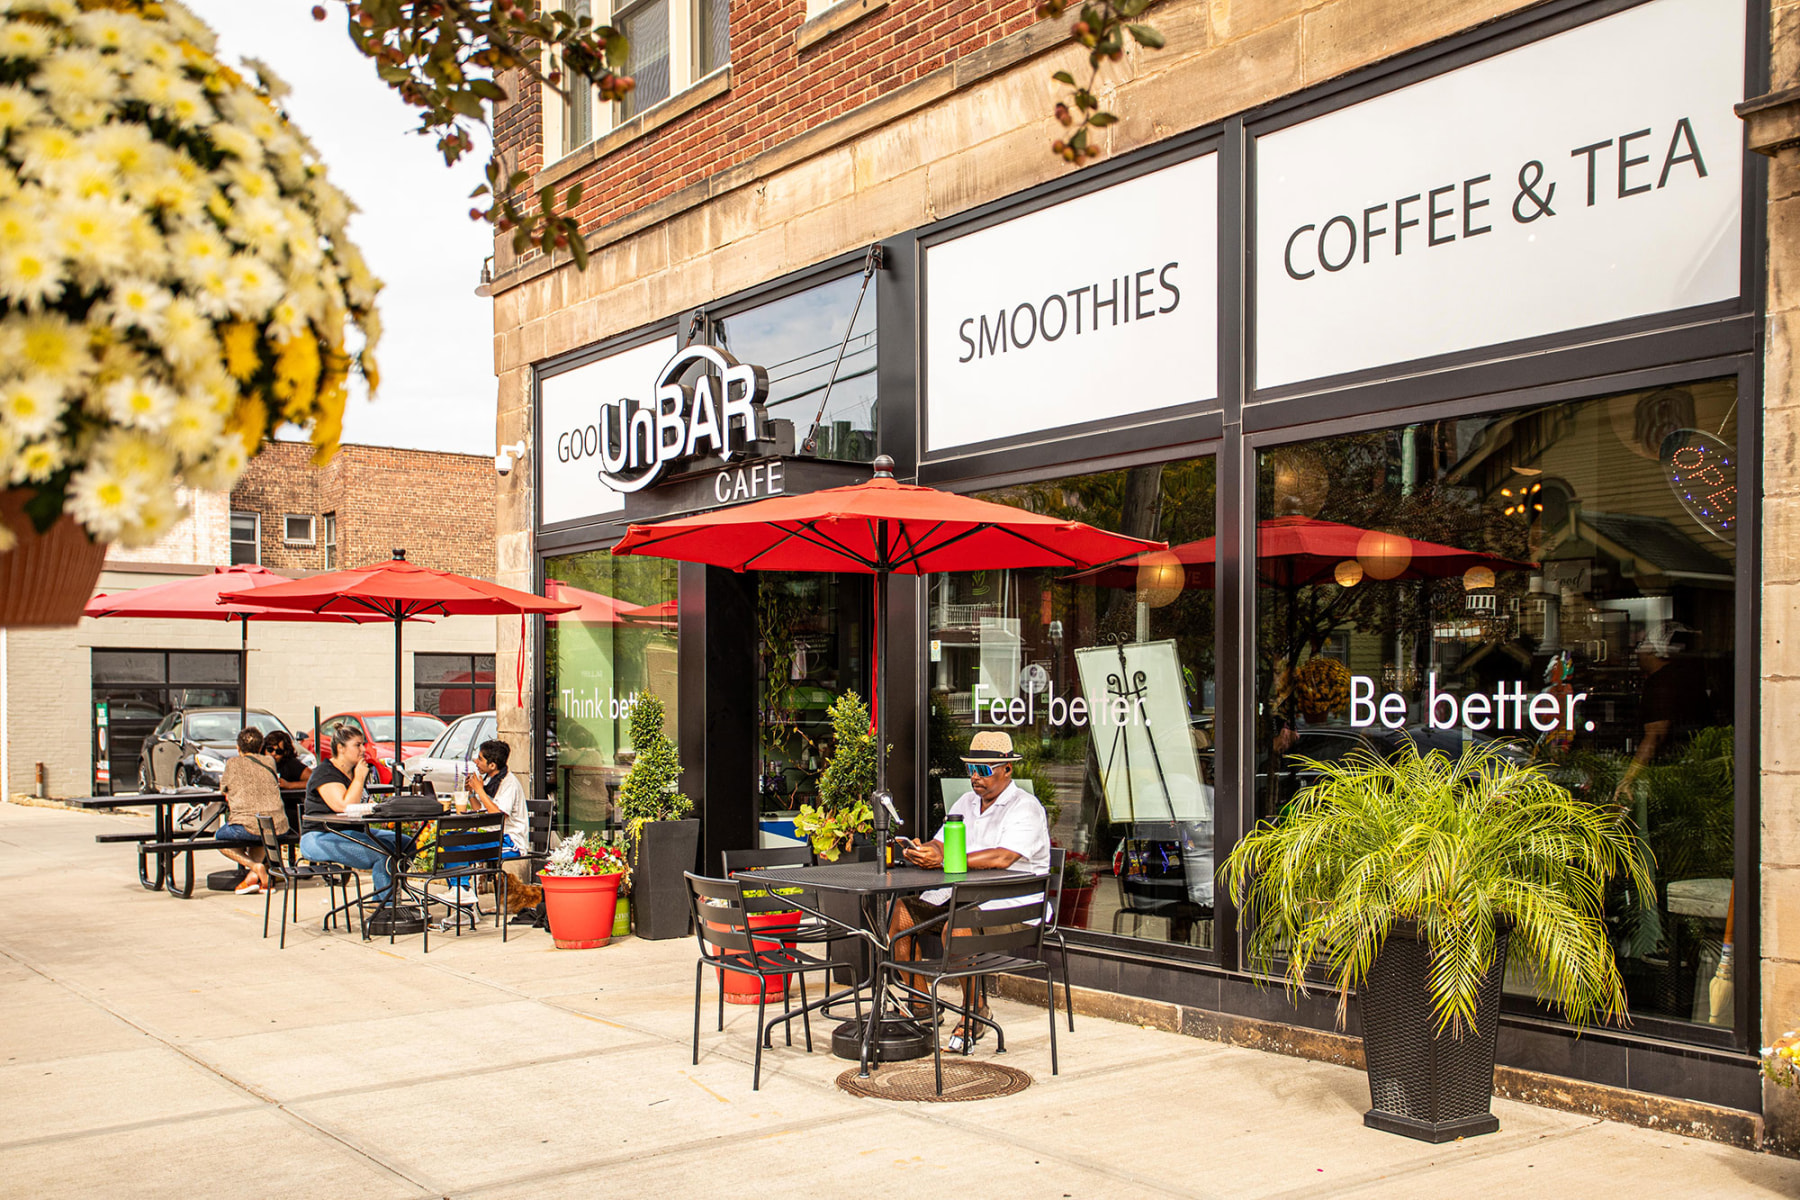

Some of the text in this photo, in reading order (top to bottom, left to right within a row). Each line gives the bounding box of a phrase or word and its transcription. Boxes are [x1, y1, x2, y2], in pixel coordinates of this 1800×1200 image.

[1284, 116, 1709, 281] COFFEE & TEA
[958, 261, 1181, 363] SMOOTHIES
[558, 424, 602, 463] GOO
[714, 461, 784, 504] CAFE
[1672, 446, 1737, 521] OPE
[561, 687, 604, 719] Think
[974, 680, 1152, 727] Feel better.
[1350, 671, 1596, 731] Be better.
